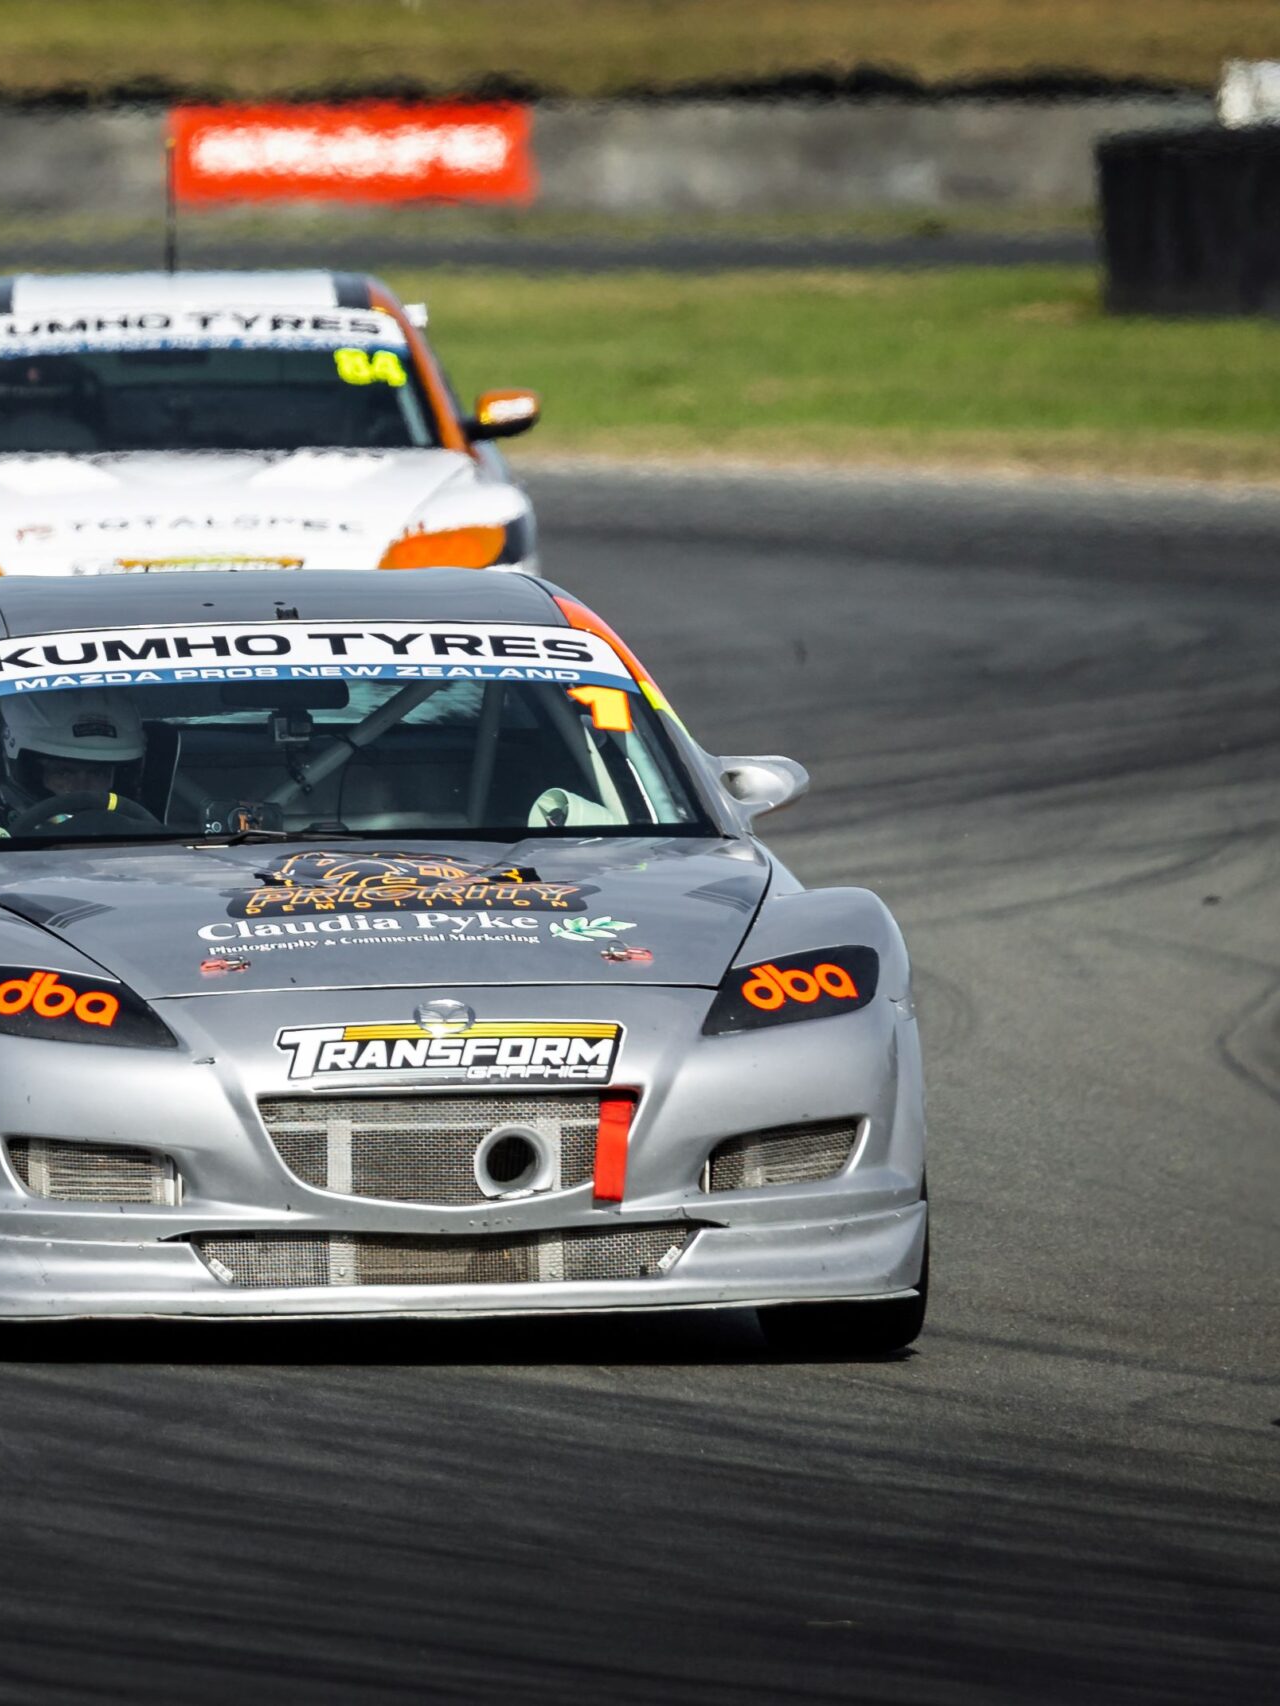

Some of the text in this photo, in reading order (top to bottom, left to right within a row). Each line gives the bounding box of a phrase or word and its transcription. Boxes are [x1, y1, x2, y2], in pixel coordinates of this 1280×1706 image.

[185, 310, 380, 335] TYRES
[307, 632, 594, 663] TYRES
[15, 665, 580, 691] MAZDA PRO8 NEW ZEALAND
[567, 684, 633, 732] 1
[246, 883, 582, 909] PRIORITY
[197, 911, 539, 941] Claudia Pyke
[208, 933, 541, 956] Photography & Commercial Marketing
[740, 963, 859, 1012] dba
[280, 1028, 615, 1079] TRANSFORM
[466, 1064, 608, 1080] GRAPHICS
